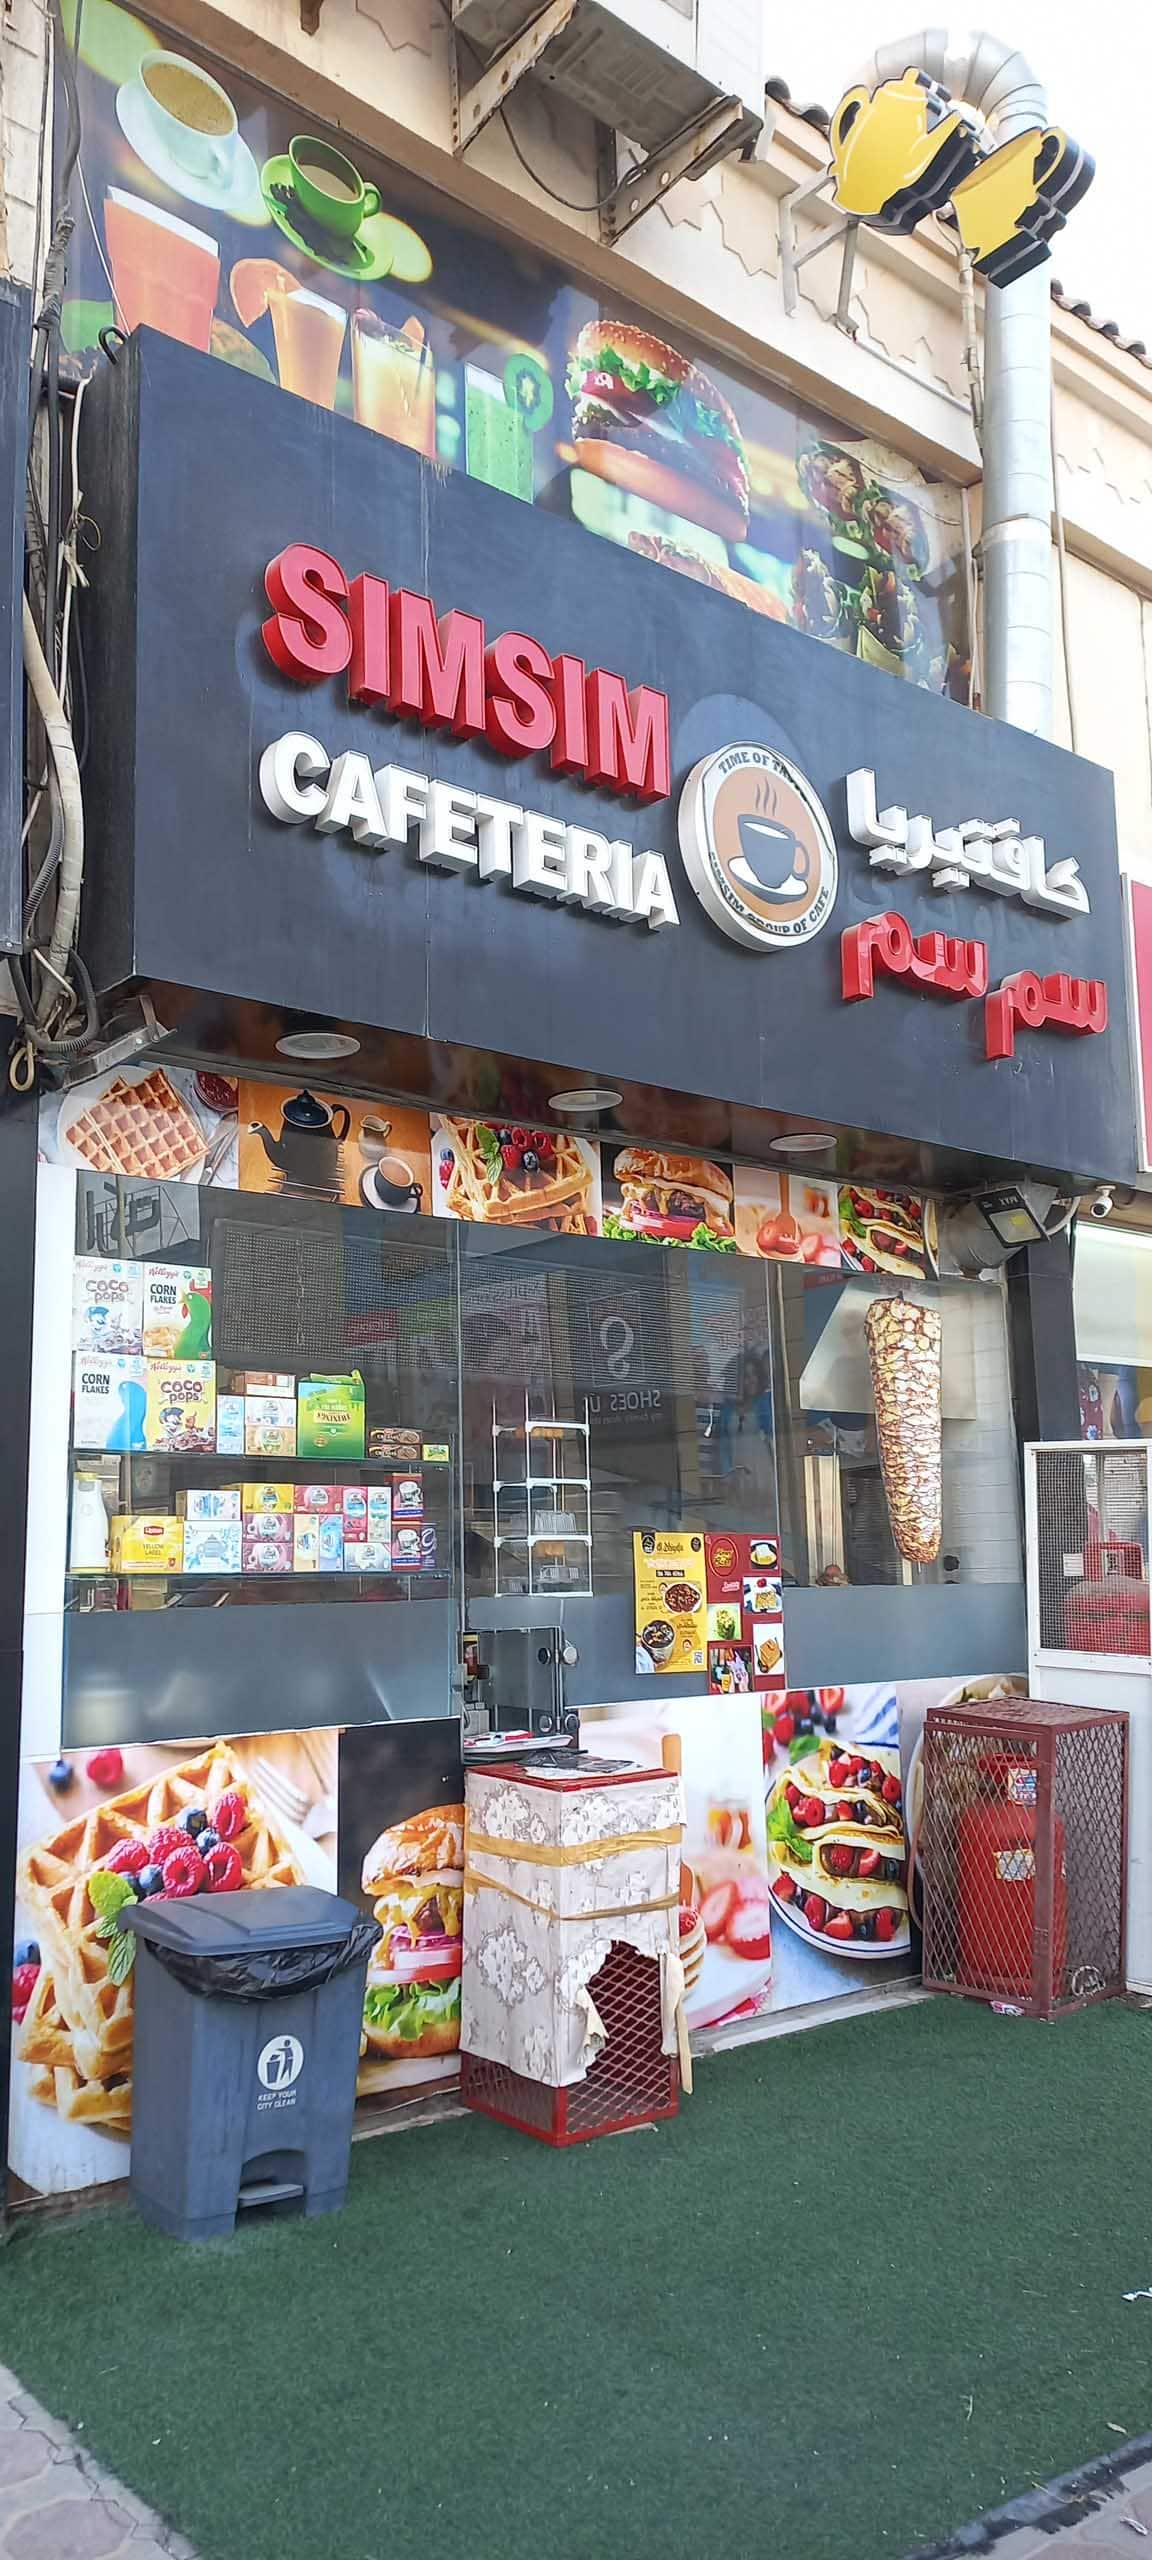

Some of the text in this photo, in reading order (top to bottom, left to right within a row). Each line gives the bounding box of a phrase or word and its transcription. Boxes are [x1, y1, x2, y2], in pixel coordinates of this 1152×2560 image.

[262, 543, 671, 804] SIMSIM
[718, 751, 751, 774] TIME
[752, 752, 770, 766] OF
[259, 731, 681, 931] CAFETERIA
[846, 767, 1091, 919] كافتيريا
[793, 918, 808, 934] OF
[809, 886, 830, 923] CAFE
[841, 911, 1109, 1061] سم سم
[150, 1283, 177, 1296] CORN
[150, 1294, 177, 1305] FLAKES
[81, 1373, 111, 1386] CORN
[81, 1384, 110, 1395] FLAKES
[257, 2099, 296, 2111] CITY CLEAN
[258, 2090, 297, 2102] KEEP YOUR
